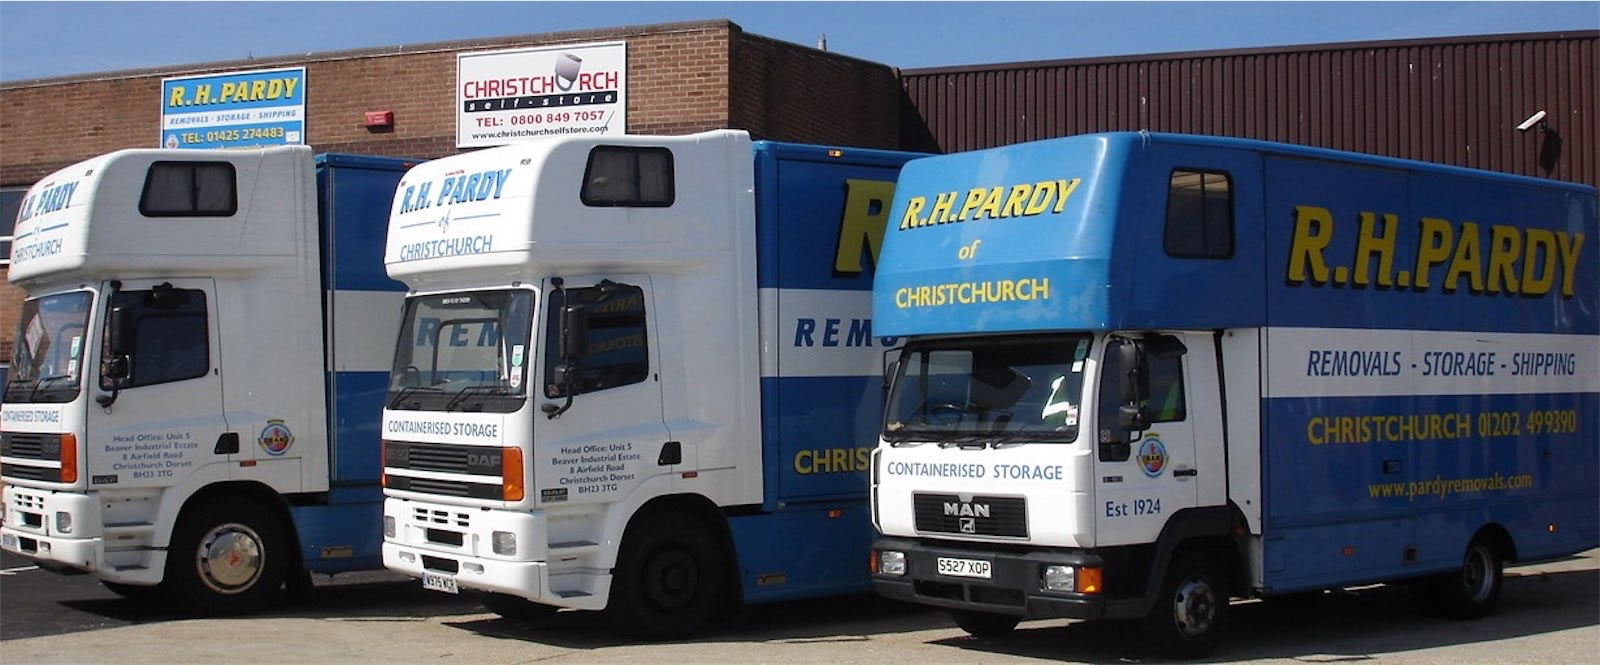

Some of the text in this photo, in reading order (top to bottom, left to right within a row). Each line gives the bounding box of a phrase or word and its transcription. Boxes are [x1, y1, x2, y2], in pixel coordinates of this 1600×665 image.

[168, 77, 299, 107] R.H.PARDY
[170, 115, 209, 125] REMOVALS
[216, 112, 250, 122] STORAGE
[259, 109, 296, 119] SHIPPING
[476, 110, 605, 128] TEL: 0800 849 7057
[181, 132, 204, 144] TEL:
[207, 130, 239, 141] 01425
[243, 127, 284, 139] 274483
[471, 126, 609, 140] www.christchurchselfstore.com
[35, 181, 79, 217] PARDY
[399, 168, 512, 215] R.H. PARDY
[898, 177, 1081, 231] R.H.PARDY
[14, 238, 62, 264] CHRISTCHURCH
[399, 235, 493, 262] CHRISTCHURCH
[958, 239, 981, 260] of
[1286, 204, 1585, 299] R.H.PARDY
[895, 277, 1049, 309] CHRISTCHURCH
[1306, 350, 1401, 377] REMOVALS
[1422, 351, 1495, 377] STORAGE
[1511, 352, 1575, 377] SHIPPING
[388, 420, 498, 438] CONTAINERISED STORAGE
[1307, 410, 1577, 445] CHRISTCHURCH 01202 499390
[130, 452, 160, 460] Airfield
[163, 451, 183, 459] Road
[135, 442, 171, 451] Industrial
[561, 446, 581, 454] Head
[583, 444, 607, 453] Office:
[609, 443, 626, 451] Unit
[113, 460, 192, 470] Christchurch Dorset
[467, 454, 500, 467] DAF
[552, 453, 641, 465] Beaver Industrial Estate
[794, 447, 873, 475] CHRIS
[576, 465, 604, 473] Airfield
[606, 464, 625, 472] Road
[887, 461, 1063, 480] CONTAINERISED STORAGE
[559, 473, 635, 484] Christchurch Dorset
[1368, 472, 1533, 501] www.pardyremovals.com
[578, 484, 618, 493] BH23 3TG
[943, 501, 991, 518] MAN
[1105, 498, 1161, 517] Est 1924
[939, 559, 989, 575] S527 XOP
